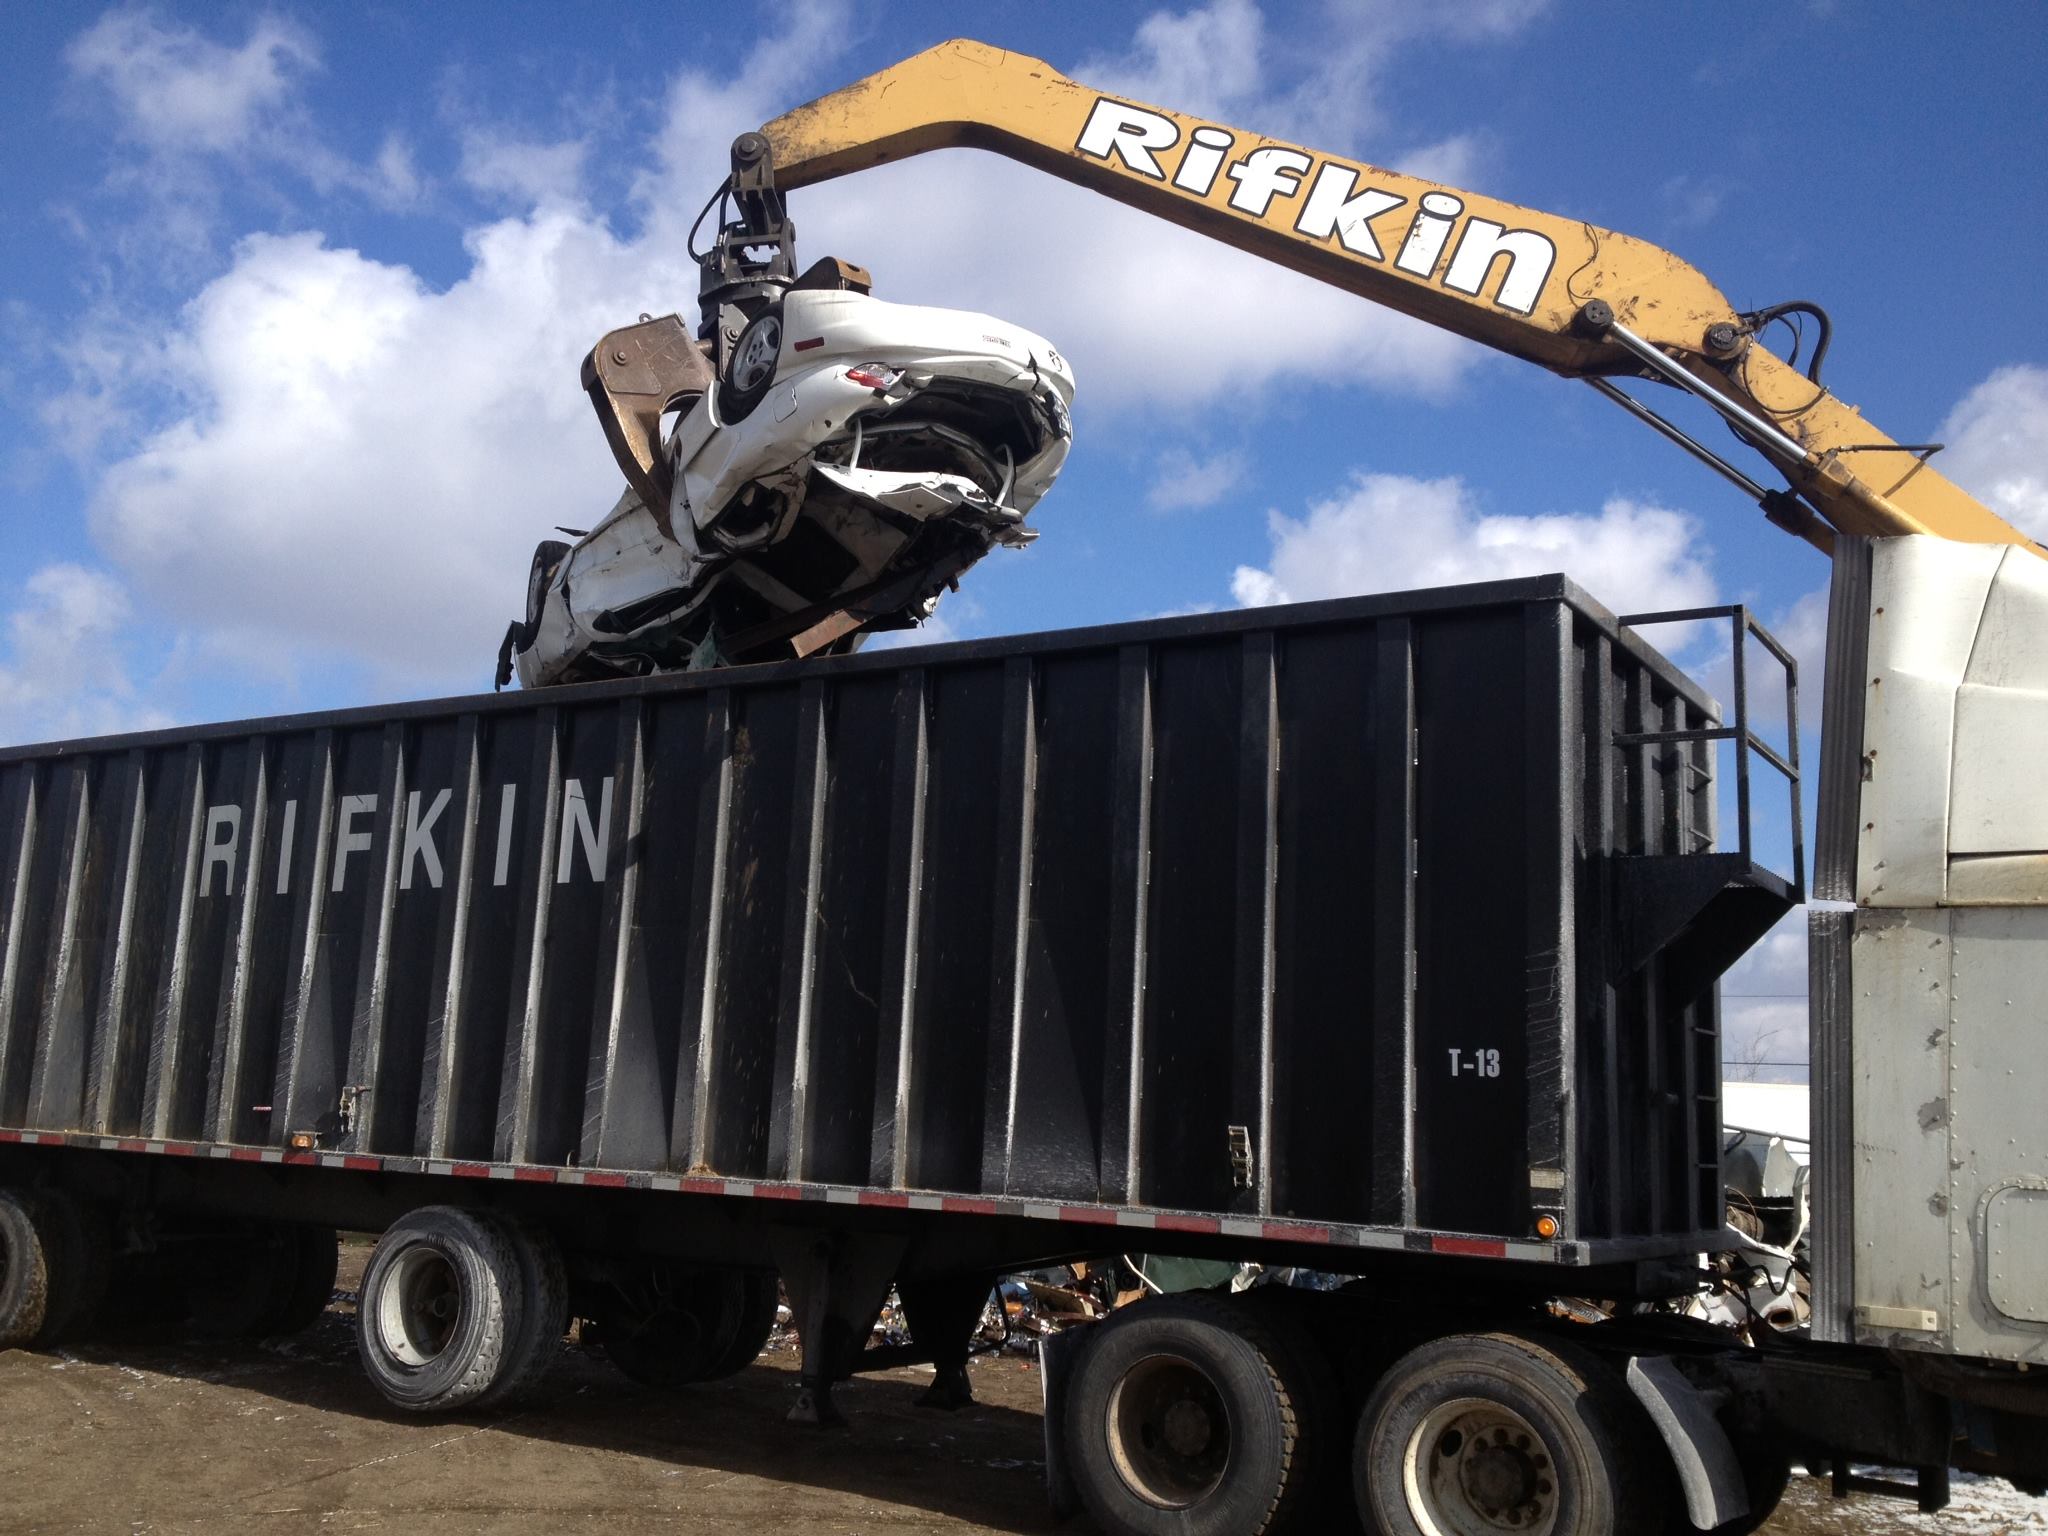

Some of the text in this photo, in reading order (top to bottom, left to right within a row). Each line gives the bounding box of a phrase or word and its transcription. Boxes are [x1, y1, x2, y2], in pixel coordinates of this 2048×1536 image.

[1075, 97, 1557, 316] Rifkin
[199, 776, 615, 898] RIFKIN
[1448, 1048, 1501, 1078] T-13
